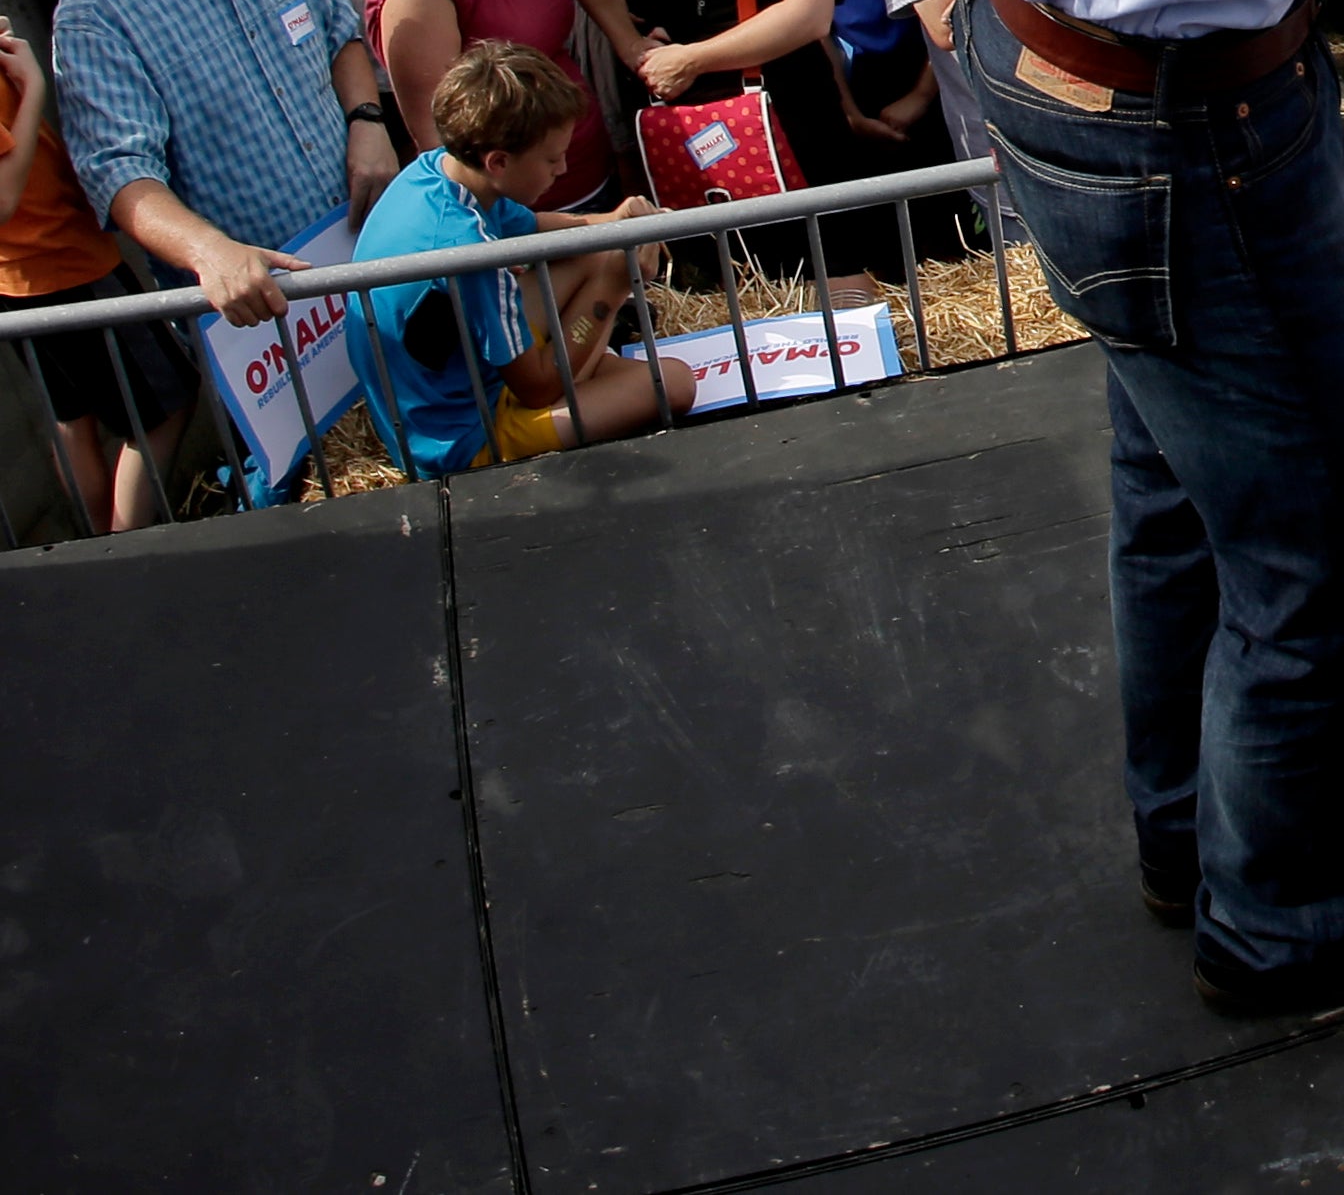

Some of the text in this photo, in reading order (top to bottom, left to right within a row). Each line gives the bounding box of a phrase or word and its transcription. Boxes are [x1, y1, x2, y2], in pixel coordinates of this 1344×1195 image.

[694, 132, 727, 157] O'MALLEY
[244, 290, 348, 395] O'MALL
[256, 371, 293, 411] REBUILD
[309, 320, 347, 360] AMERICA
[691, 340, 861, 382] O'MALLE
